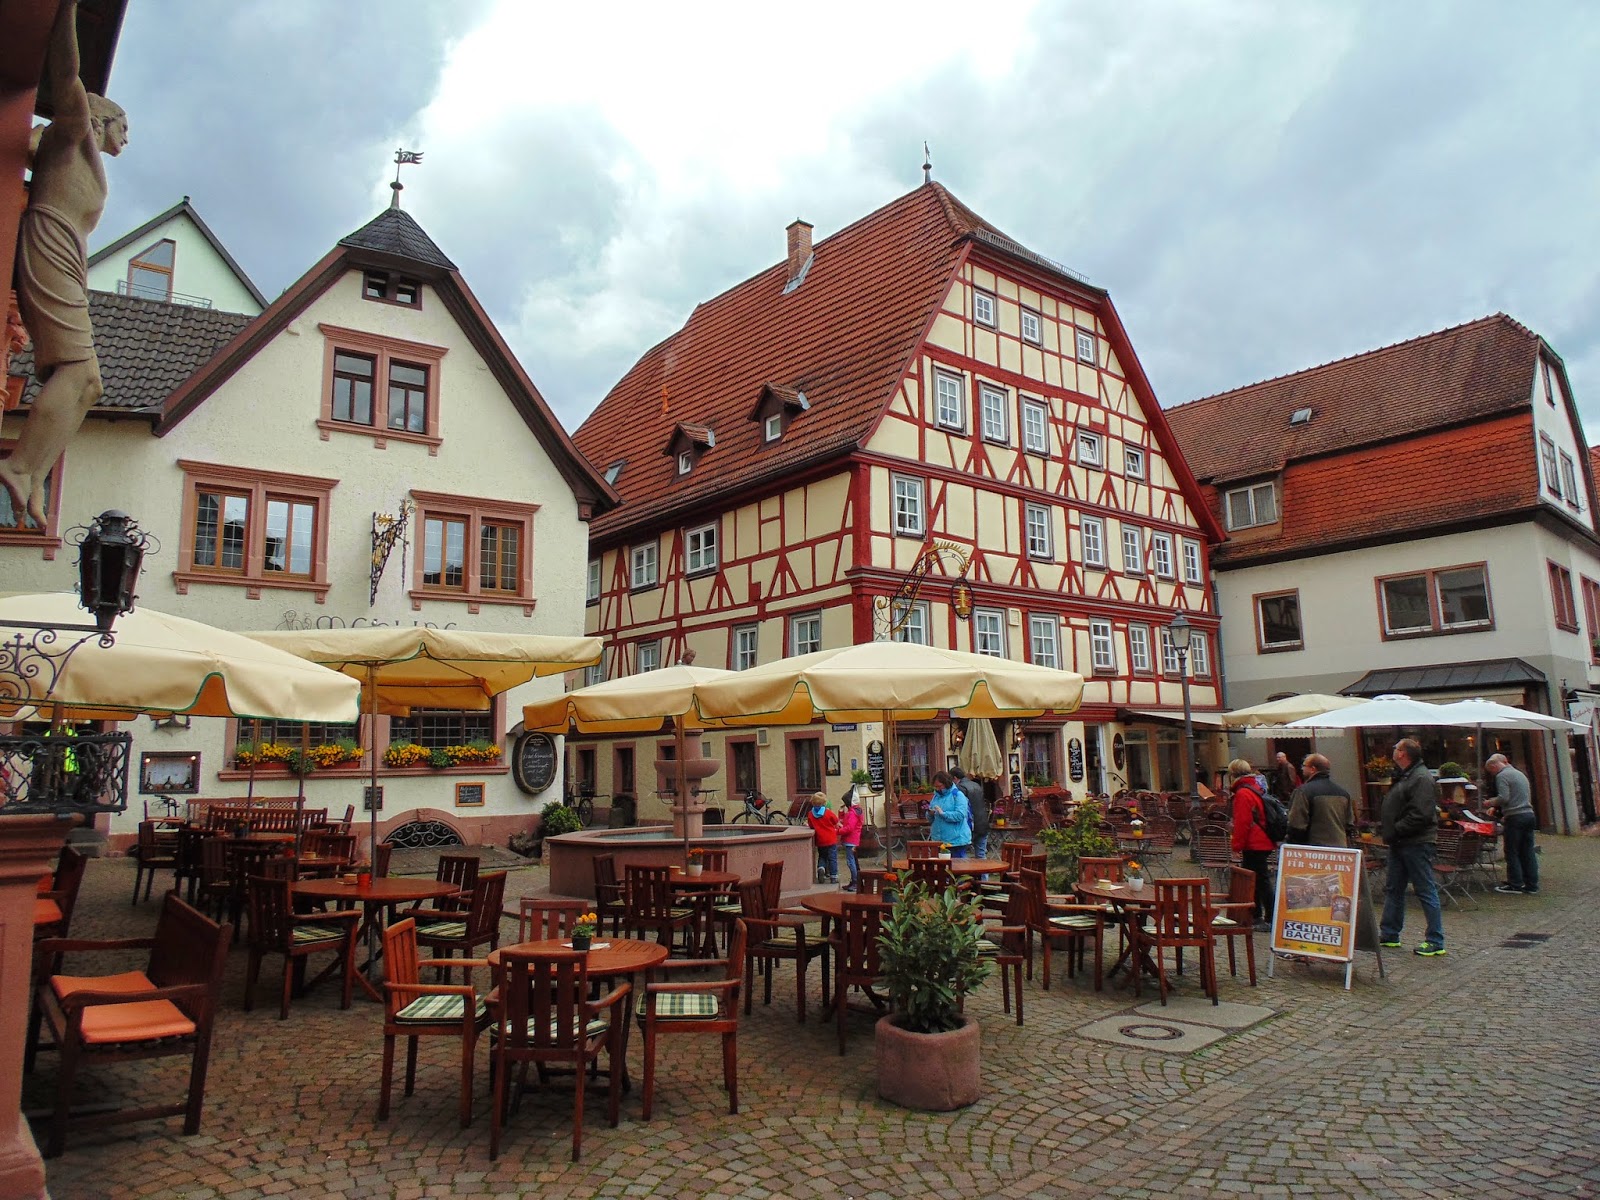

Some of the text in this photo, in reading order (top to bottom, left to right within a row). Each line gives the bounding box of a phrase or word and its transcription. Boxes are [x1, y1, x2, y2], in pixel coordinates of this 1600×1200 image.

[1286, 850, 1354, 862] DAS MODEHAUS
[1287, 858, 1305, 868] FÜR
[1308, 862, 1323, 870] SIE
[1334, 864, 1351, 872] IHN
[1285, 922, 1341, 936] SCHNEE
[1285, 930, 1339, 944] BACHER
